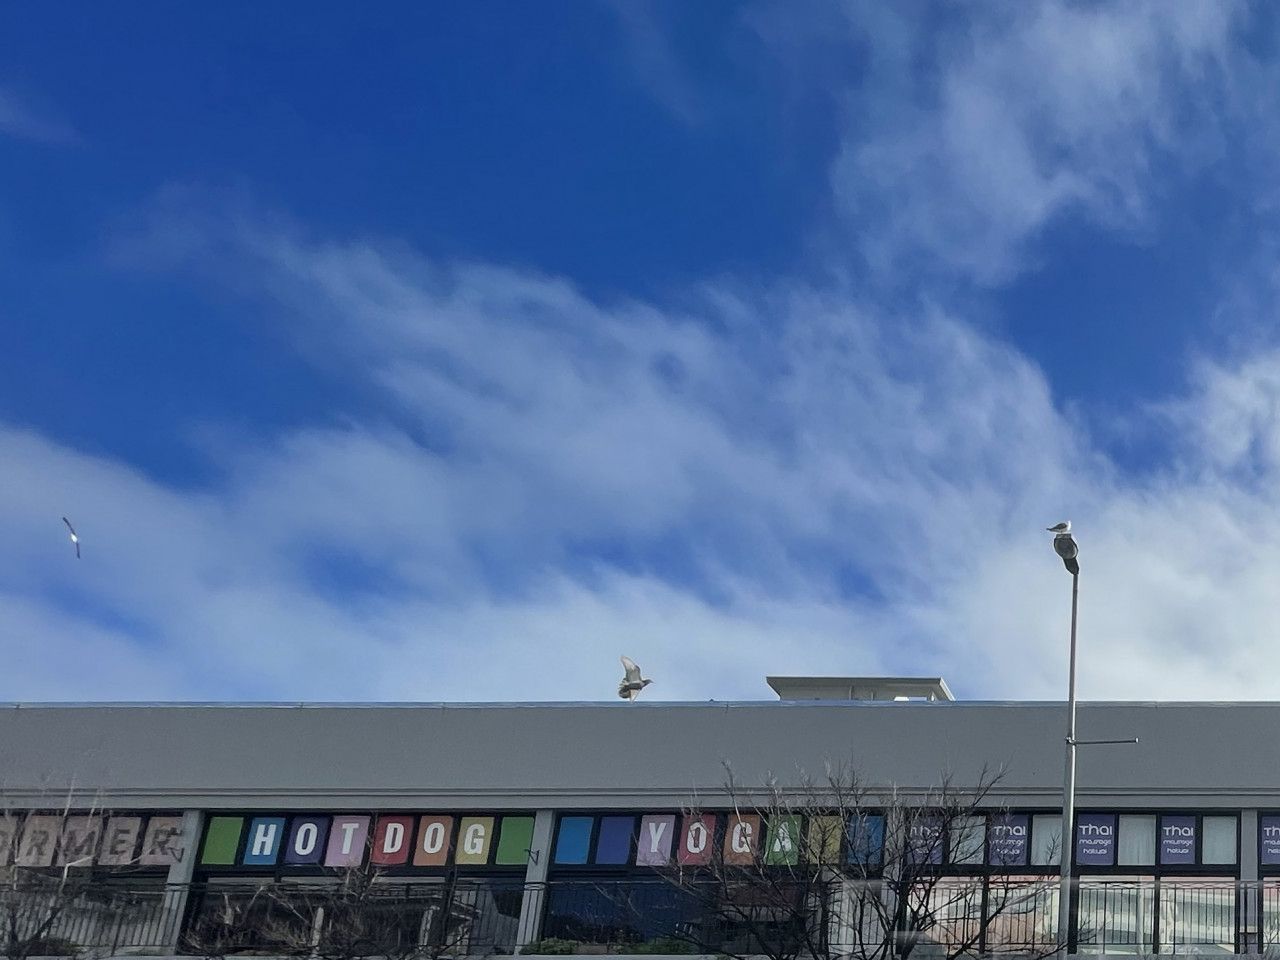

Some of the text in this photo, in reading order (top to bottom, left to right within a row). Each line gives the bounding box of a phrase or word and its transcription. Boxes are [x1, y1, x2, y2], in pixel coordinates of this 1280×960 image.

[994, 825, 1026, 836] Thai
[1079, 823, 1113, 836] Thai
[1163, 825, 1194, 837] Thai
[649, 822, 792, 853] YOGA
